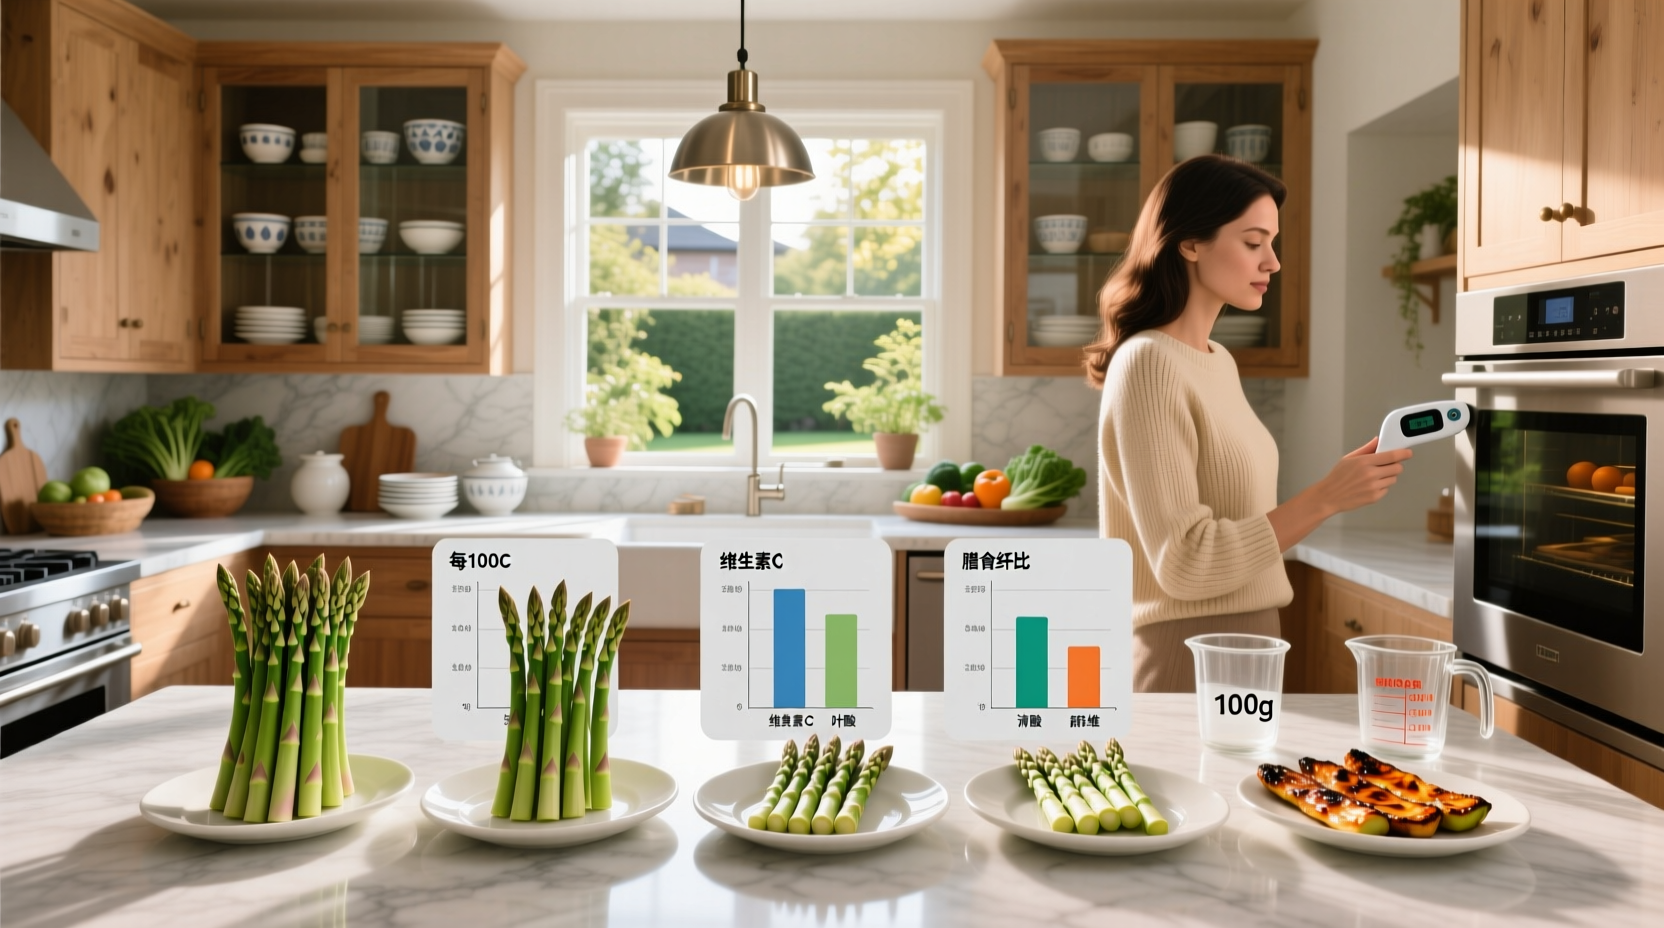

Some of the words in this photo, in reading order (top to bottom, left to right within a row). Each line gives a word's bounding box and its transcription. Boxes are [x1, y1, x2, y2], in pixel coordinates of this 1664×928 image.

[720, 551, 783, 570] 维生素C
[1215, 693, 1273, 722] 100g
